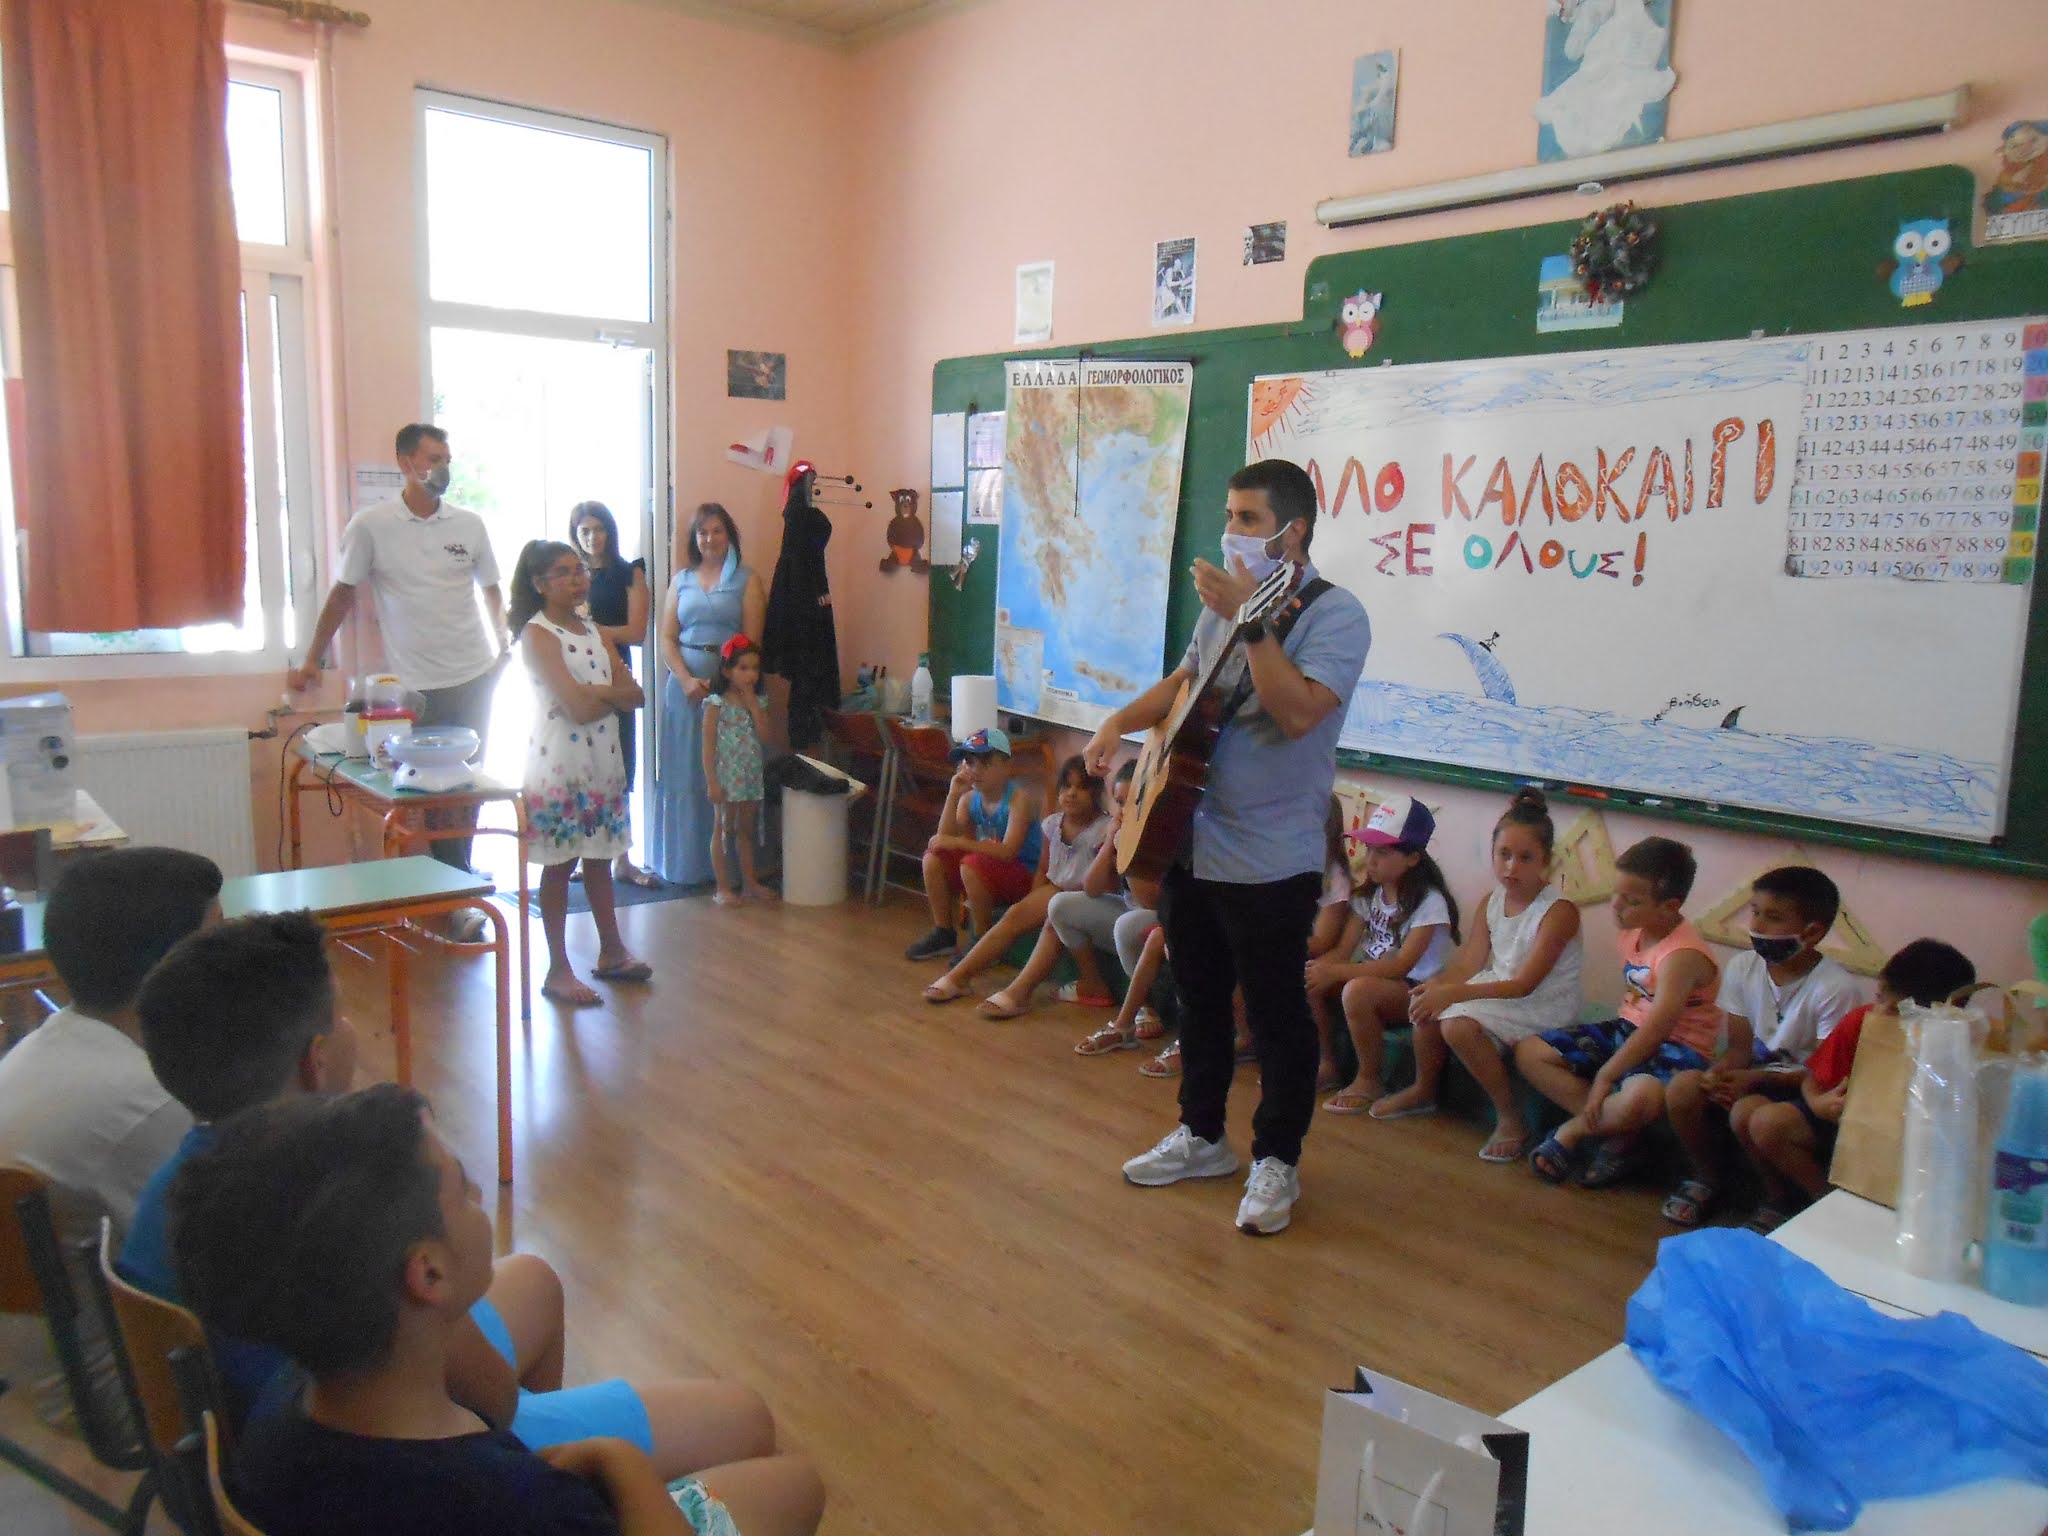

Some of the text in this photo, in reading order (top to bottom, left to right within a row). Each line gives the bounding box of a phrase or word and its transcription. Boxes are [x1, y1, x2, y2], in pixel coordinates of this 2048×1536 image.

[1838, 344, 1849, 360] 2
[1860, 342, 1870, 358] 3
[1883, 341, 1894, 356] 4
[1907, 340, 1917, 355] 5
[1931, 338, 1942, 353] 6
[1956, 336, 1966, 351] 7
[1980, 333, 1990, 350] 8
[2004, 332, 2016, 348] 9
[1012, 367, 1185, 386] ΕΛΛΑΔΑ ΓΕΩΜΟΡΦΟΛΟΓΙΚΟΣ
[1812, 370, 1827, 384] 11
[1835, 368, 1852, 383] 12
[1858, 367, 1874, 382] 13
[1880, 365, 1898, 381] 14
[1904, 364, 1922, 380] 15
[1924, 363, 1942, 378] 16
[1950, 361, 1968, 376] 17
[1976, 359, 1996, 375] 18
[1803, 393, 1821, 408] 21
[1827, 392, 1847, 408] 22
[1850, 391, 1870, 406] 23
[1874, 390, 1896, 406] 24
[1900, 388, 1921, 404] 25
[1920, 387, 1942, 403] 26
[1946, 386, 1968, 402] 27
[1972, 384, 1994, 400] 28
[1999, 383, 2022, 400] 29
[1801, 416, 1818, 432] 31
[1827, 416, 1844, 431] 32
[1848, 415, 1868, 430] 33
[1896, 414, 1918, 430] 35
[1798, 442, 1816, 456] 41
[1822, 440, 1842, 456] 42
[1845, 440, 1865, 455] 43
[1869, 440, 1890, 455] 44
[1894, 438, 1915, 454] 45
[1916, 438, 1936, 453] 46
[1940, 436, 1964, 452] 47
[1966, 435, 1990, 452] 48
[1994, 434, 2017, 450] 49
[1441, 416, 1776, 527] ΚΑΛΟΚΑΙΡΙ
[1845, 464, 1862, 480] 53
[1964, 460, 1986, 476] 58
[1794, 490, 1810, 504] 61
[1816, 490, 1835, 504] 62
[1839, 488, 1858, 504] 63
[1887, 488, 1908, 504] 65
[1791, 512, 1806, 528] 71
[1814, 512, 1832, 528] 72
[1836, 512, 1855, 528] 73
[1860, 512, 1880, 528] 74
[1884, 512, 1904, 528] 75
[1910, 512, 1930, 528] 76
[1936, 512, 1956, 527] 77
[1961, 511, 1982, 528] 78
[1988, 511, 2010, 527] 79
[1369, 523, 1436, 577] ΣΕ
[1790, 536, 1806, 552] 81
[1812, 536, 1832, 552] 82
[1836, 536, 1855, 552] 83
[1860, 536, 1880, 552] 84
[1884, 537, 1904, 552] 85
[1905, 538, 1926, 553] 86
[1931, 537, 1952, 552] 87
[1956, 537, 1978, 552] 88
[1984, 537, 2006, 553] 89
[1902, 561, 1924, 577] 96
